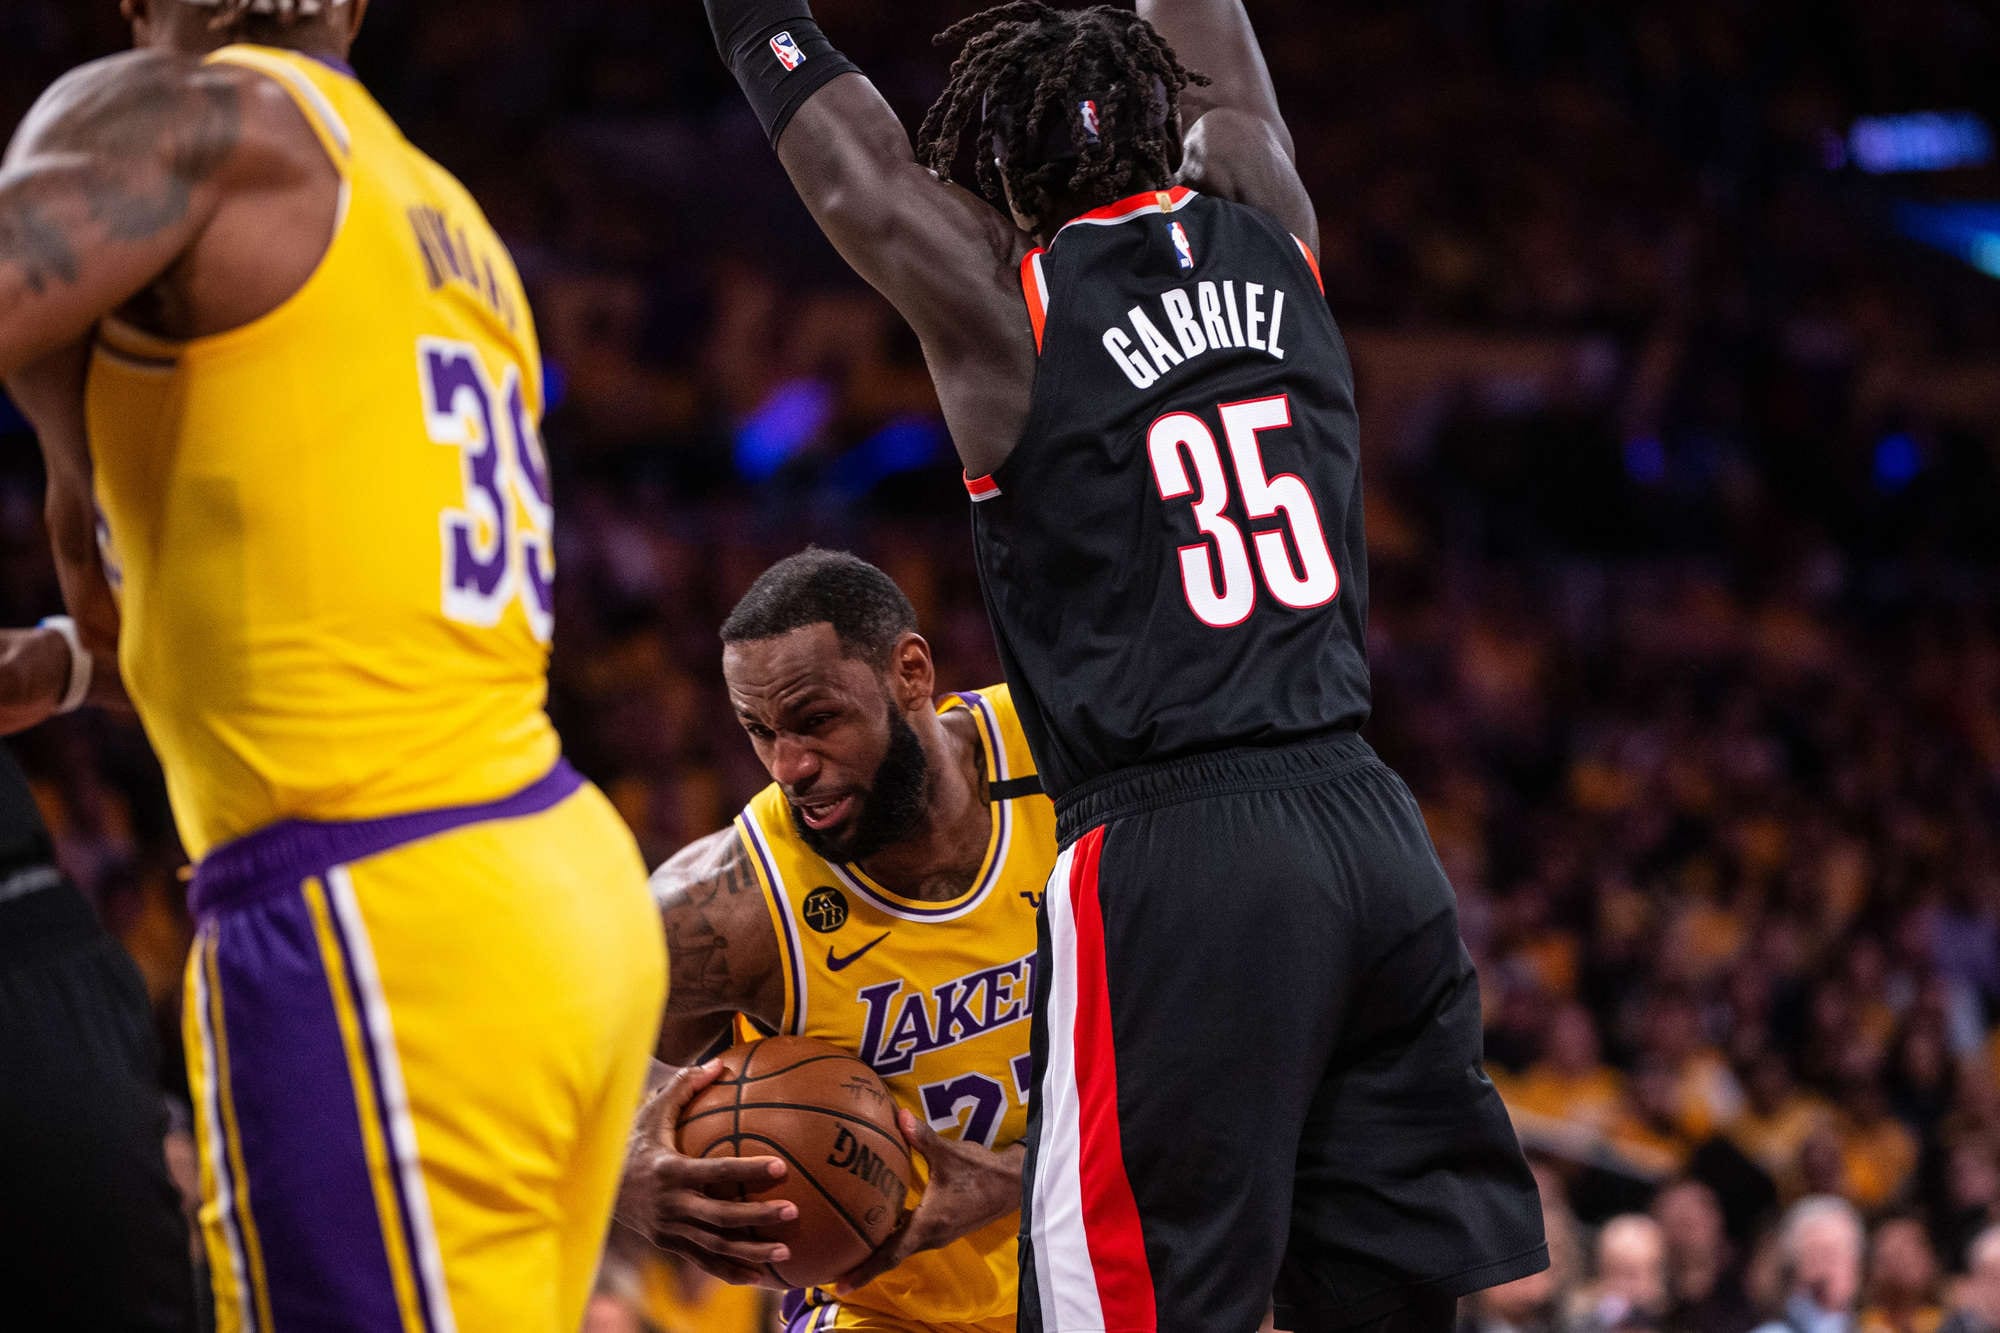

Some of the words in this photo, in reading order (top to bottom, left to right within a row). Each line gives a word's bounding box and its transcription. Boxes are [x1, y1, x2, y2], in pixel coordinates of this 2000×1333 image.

[1102, 279, 1285, 389] GABRIEL
[1146, 394, 1340, 628] 35
[918, 1053, 1031, 1149] 2
